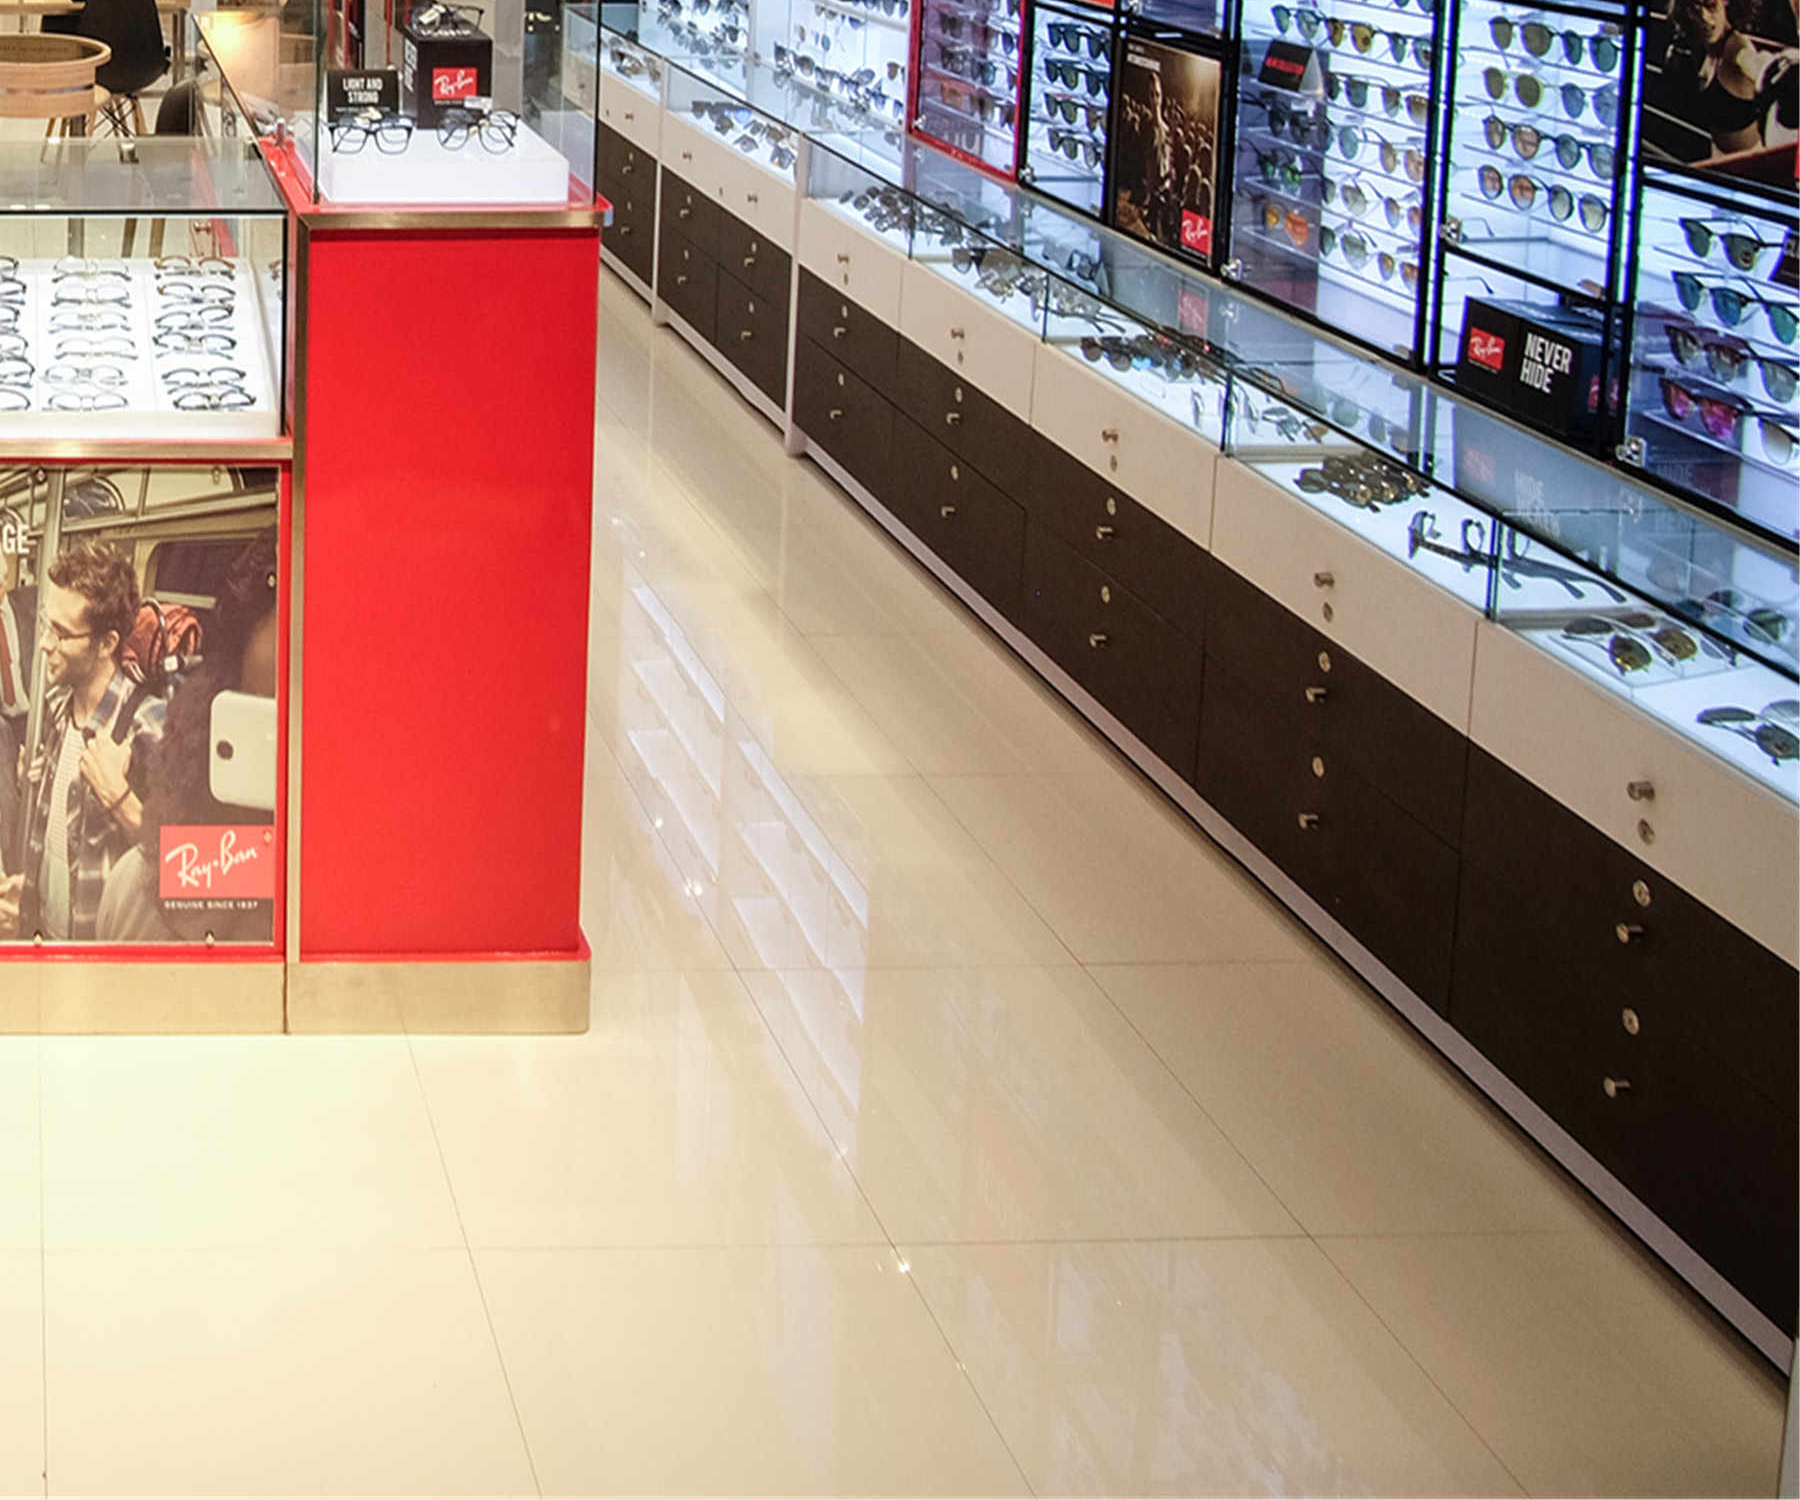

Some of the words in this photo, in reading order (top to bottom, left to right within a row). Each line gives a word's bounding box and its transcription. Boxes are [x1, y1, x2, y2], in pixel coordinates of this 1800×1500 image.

[343, 77, 365, 91] LIGHT
[366, 77, 383, 91] AND
[348, 91, 379, 104] STRONG
[1523, 332, 1574, 375] NEVER
[1519, 358, 1555, 394] HIDE
[164, 828, 259, 890] Ray-Ban
[164, 900, 204, 910] GENUINE
[207, 900, 234, 910] SINCE
